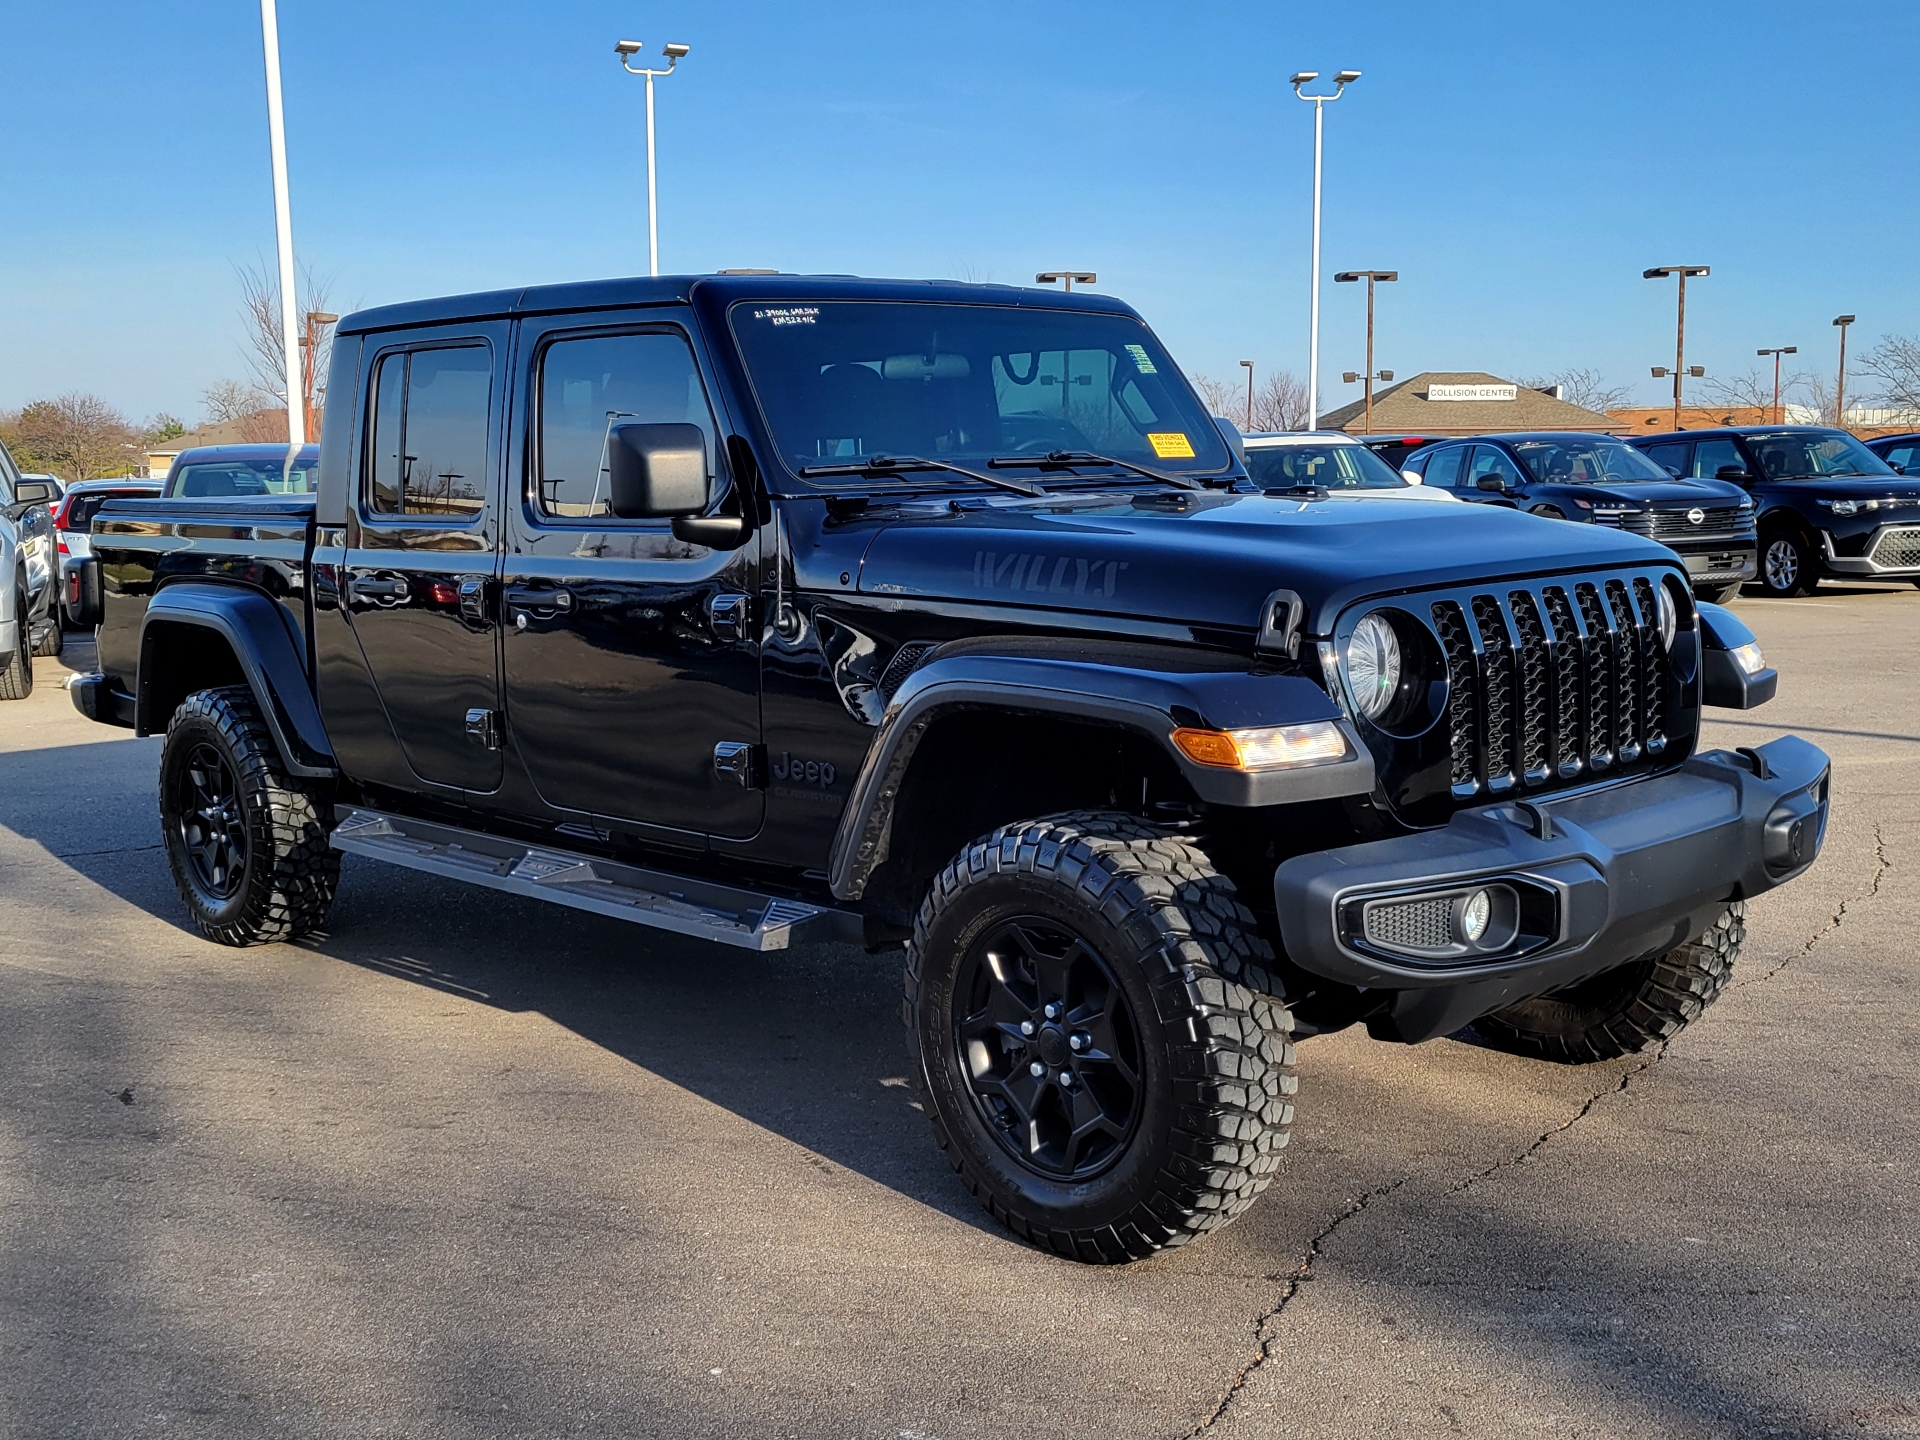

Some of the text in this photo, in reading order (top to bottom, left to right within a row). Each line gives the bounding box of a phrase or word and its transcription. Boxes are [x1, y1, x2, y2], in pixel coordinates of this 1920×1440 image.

[1430, 389, 1515, 398] COLLISION CENTER
[974, 550, 1129, 598] WILLYS
[774, 751, 835, 790] Jeep
